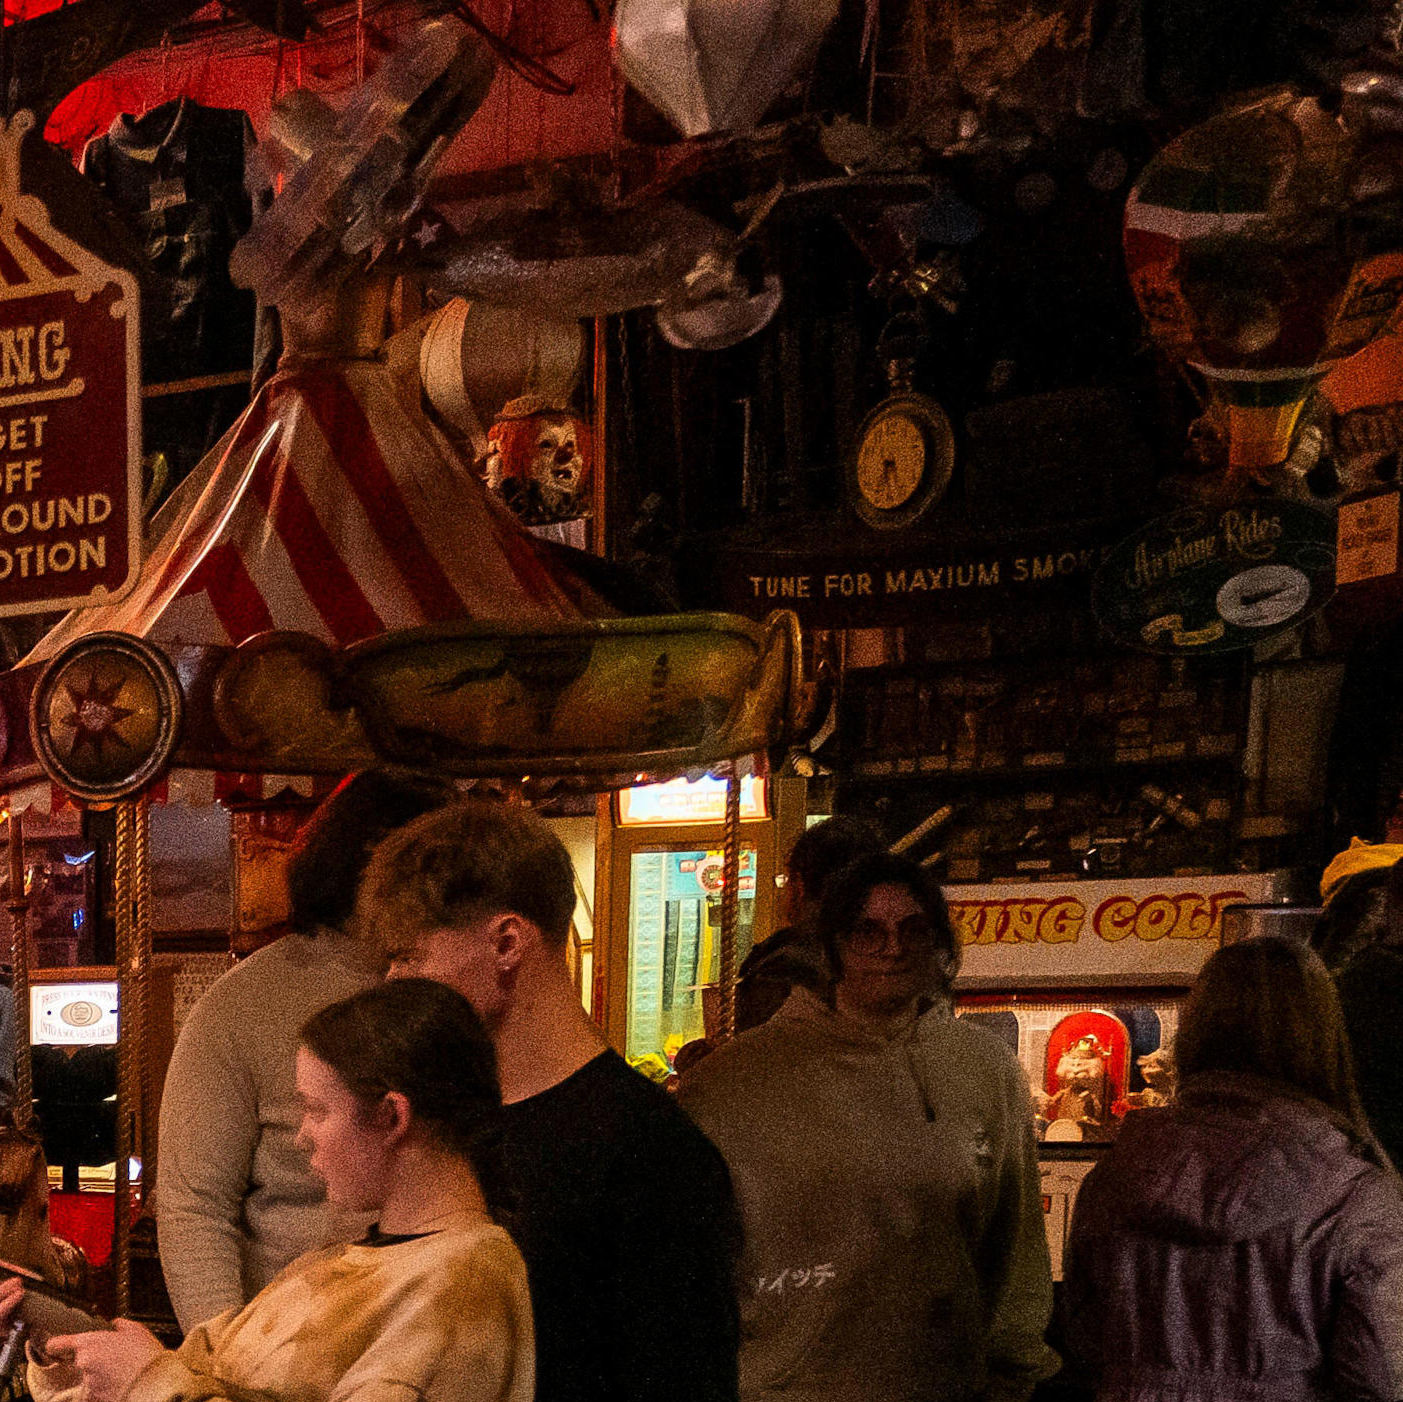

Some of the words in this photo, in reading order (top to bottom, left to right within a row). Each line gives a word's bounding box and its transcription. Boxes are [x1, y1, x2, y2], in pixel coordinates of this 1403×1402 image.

[748, 575, 811, 598] TUNE
[824, 571, 873, 598] FOR
[885, 560, 1001, 594] MAXIUM
